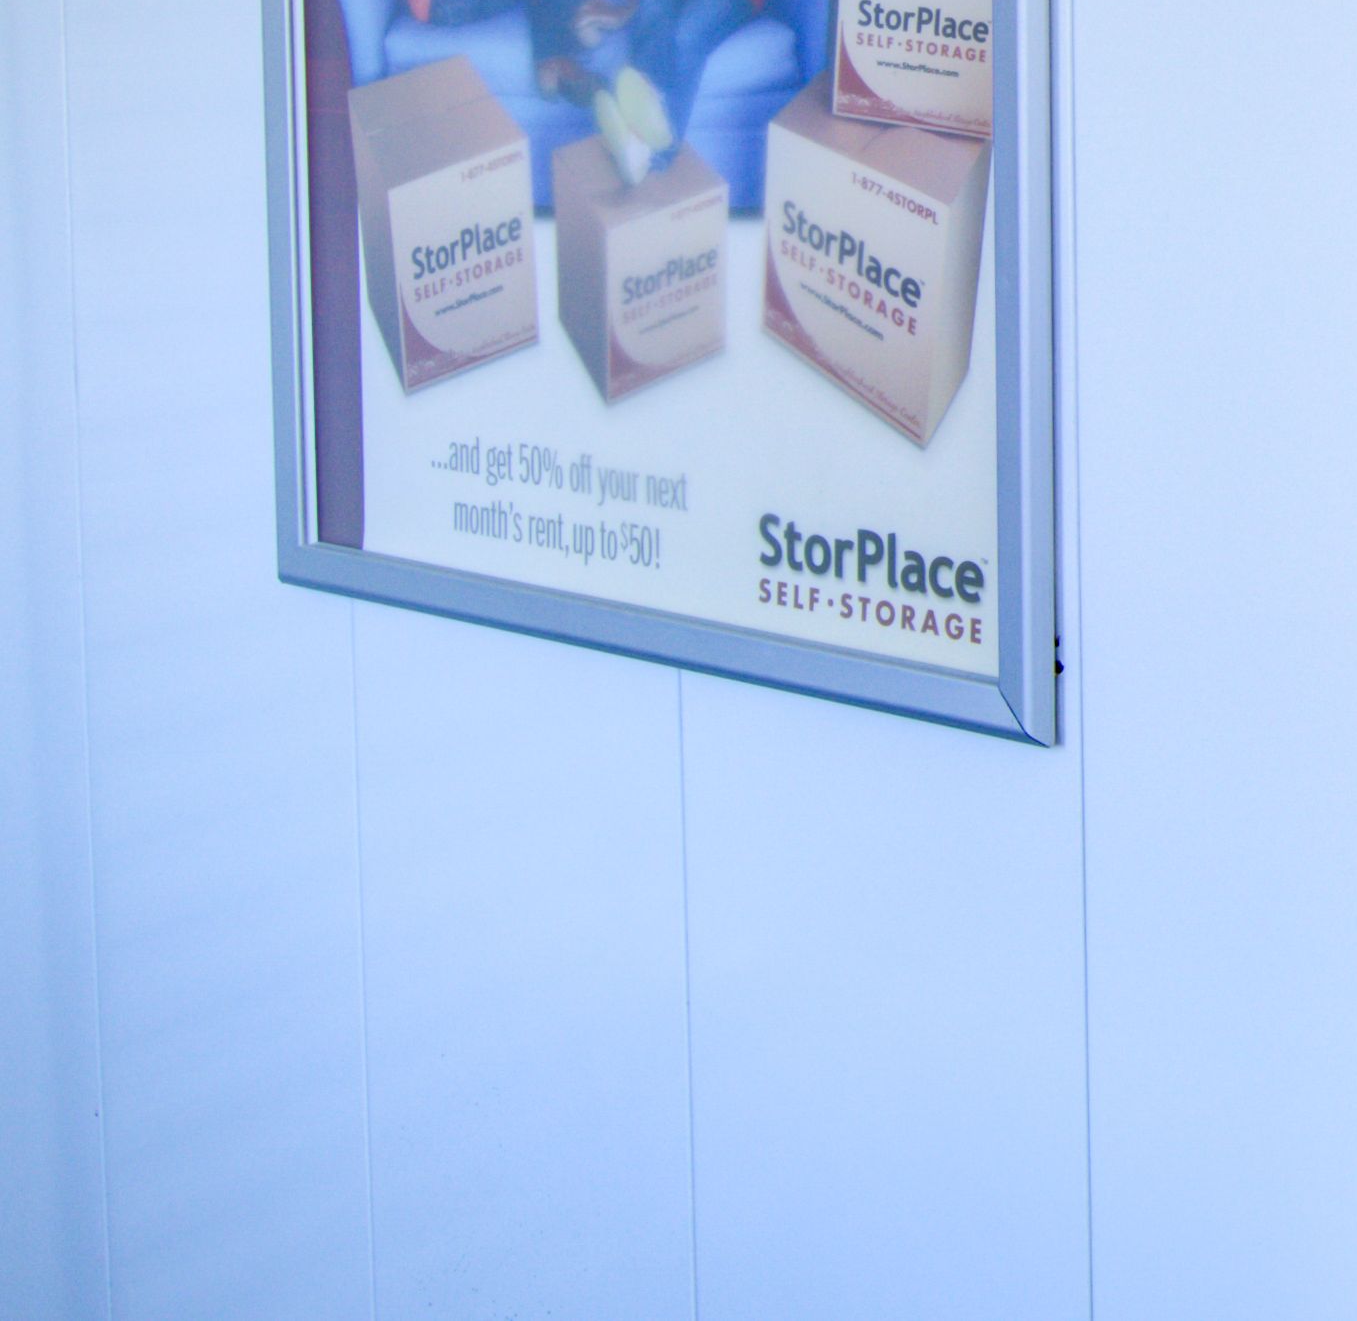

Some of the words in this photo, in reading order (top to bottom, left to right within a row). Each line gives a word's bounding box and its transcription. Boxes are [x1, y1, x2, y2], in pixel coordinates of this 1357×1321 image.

[858, 0, 990, 44] StorPlace
[851, 172, 939, 226] 1-877-4STORPL
[411, 216, 522, 280] StorPlace
[622, 248, 718, 306] StorPlace
[781, 200, 922, 309] StorPlace
[486, 443, 513, 486] get
[519, 443, 563, 489] 50%
[569, 452, 593, 495] off
[597, 466, 640, 507] your
[646, 473, 689, 512] next
[453, 500, 523, 543] month's
[573, 522, 595, 566] up
[600, 521, 618, 561] to
[759, 513, 984, 604] StorPlace
